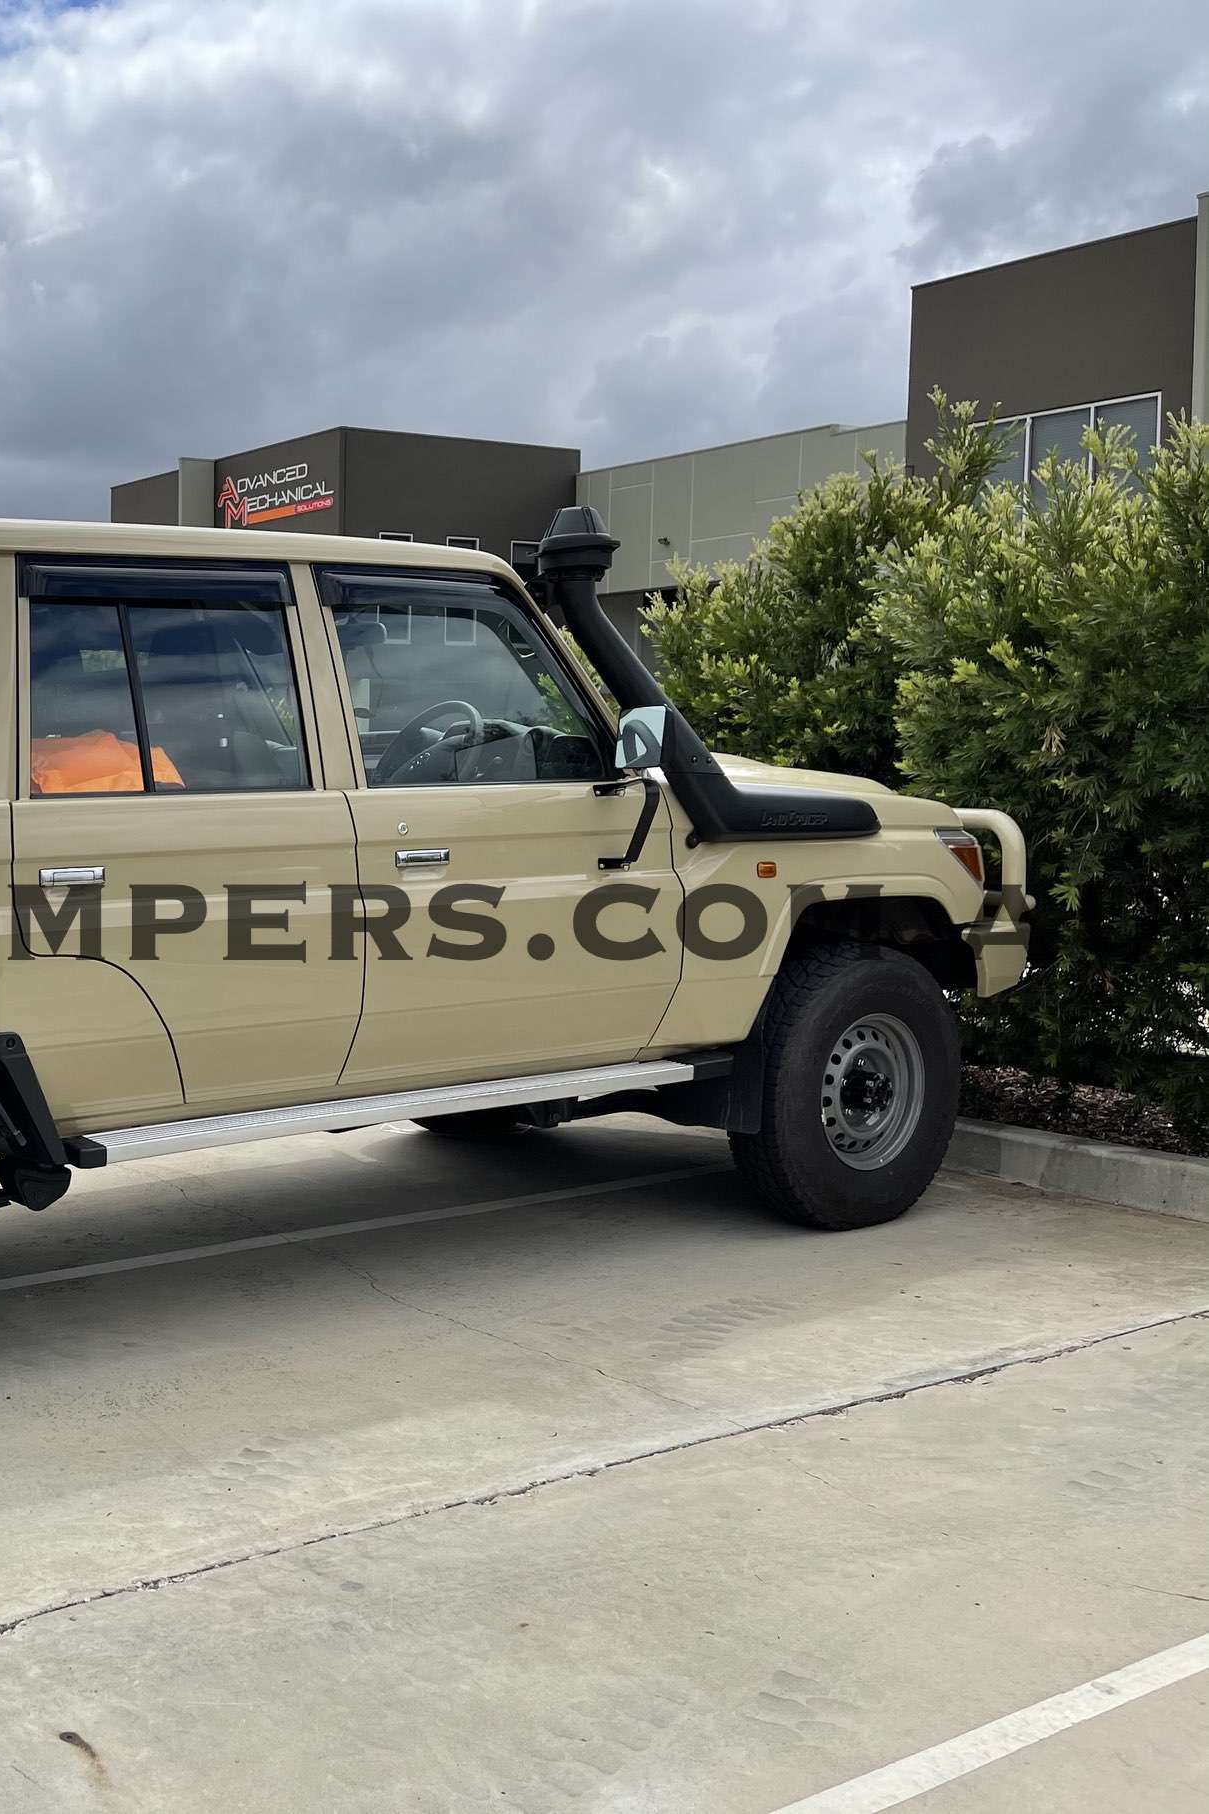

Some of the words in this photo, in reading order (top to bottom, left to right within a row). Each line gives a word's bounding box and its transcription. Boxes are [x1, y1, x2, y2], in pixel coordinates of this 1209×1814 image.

[217, 463, 308, 508] ADVANCED
[224, 481, 335, 529] MECHANICAL
[296, 499, 332, 513] SOLUTIONS
